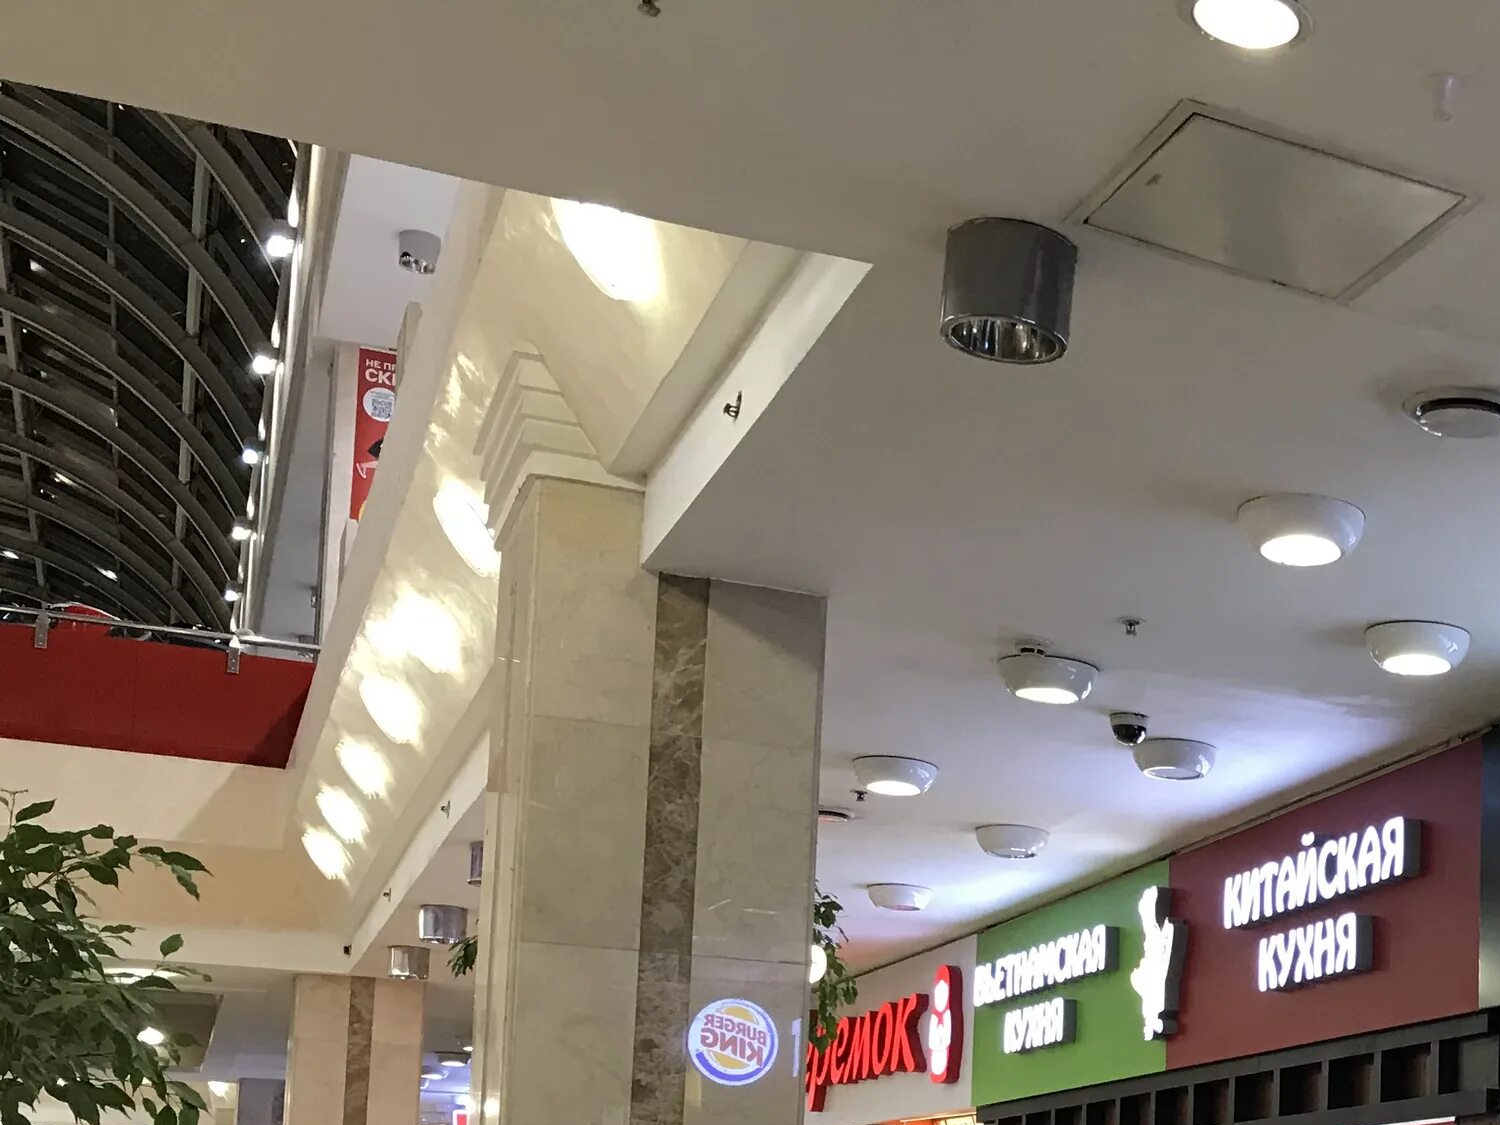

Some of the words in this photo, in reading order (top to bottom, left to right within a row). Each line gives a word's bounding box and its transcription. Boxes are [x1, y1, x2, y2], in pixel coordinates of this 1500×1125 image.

[1224, 816, 1404, 929] КИТАЙСКАЯ
[973, 924, 1106, 1007] ВЬЕТНАМСКАЯ
[1258, 912, 1357, 992] КУХНЯ
[1004, 997, 1064, 1054] КУХНЯ
